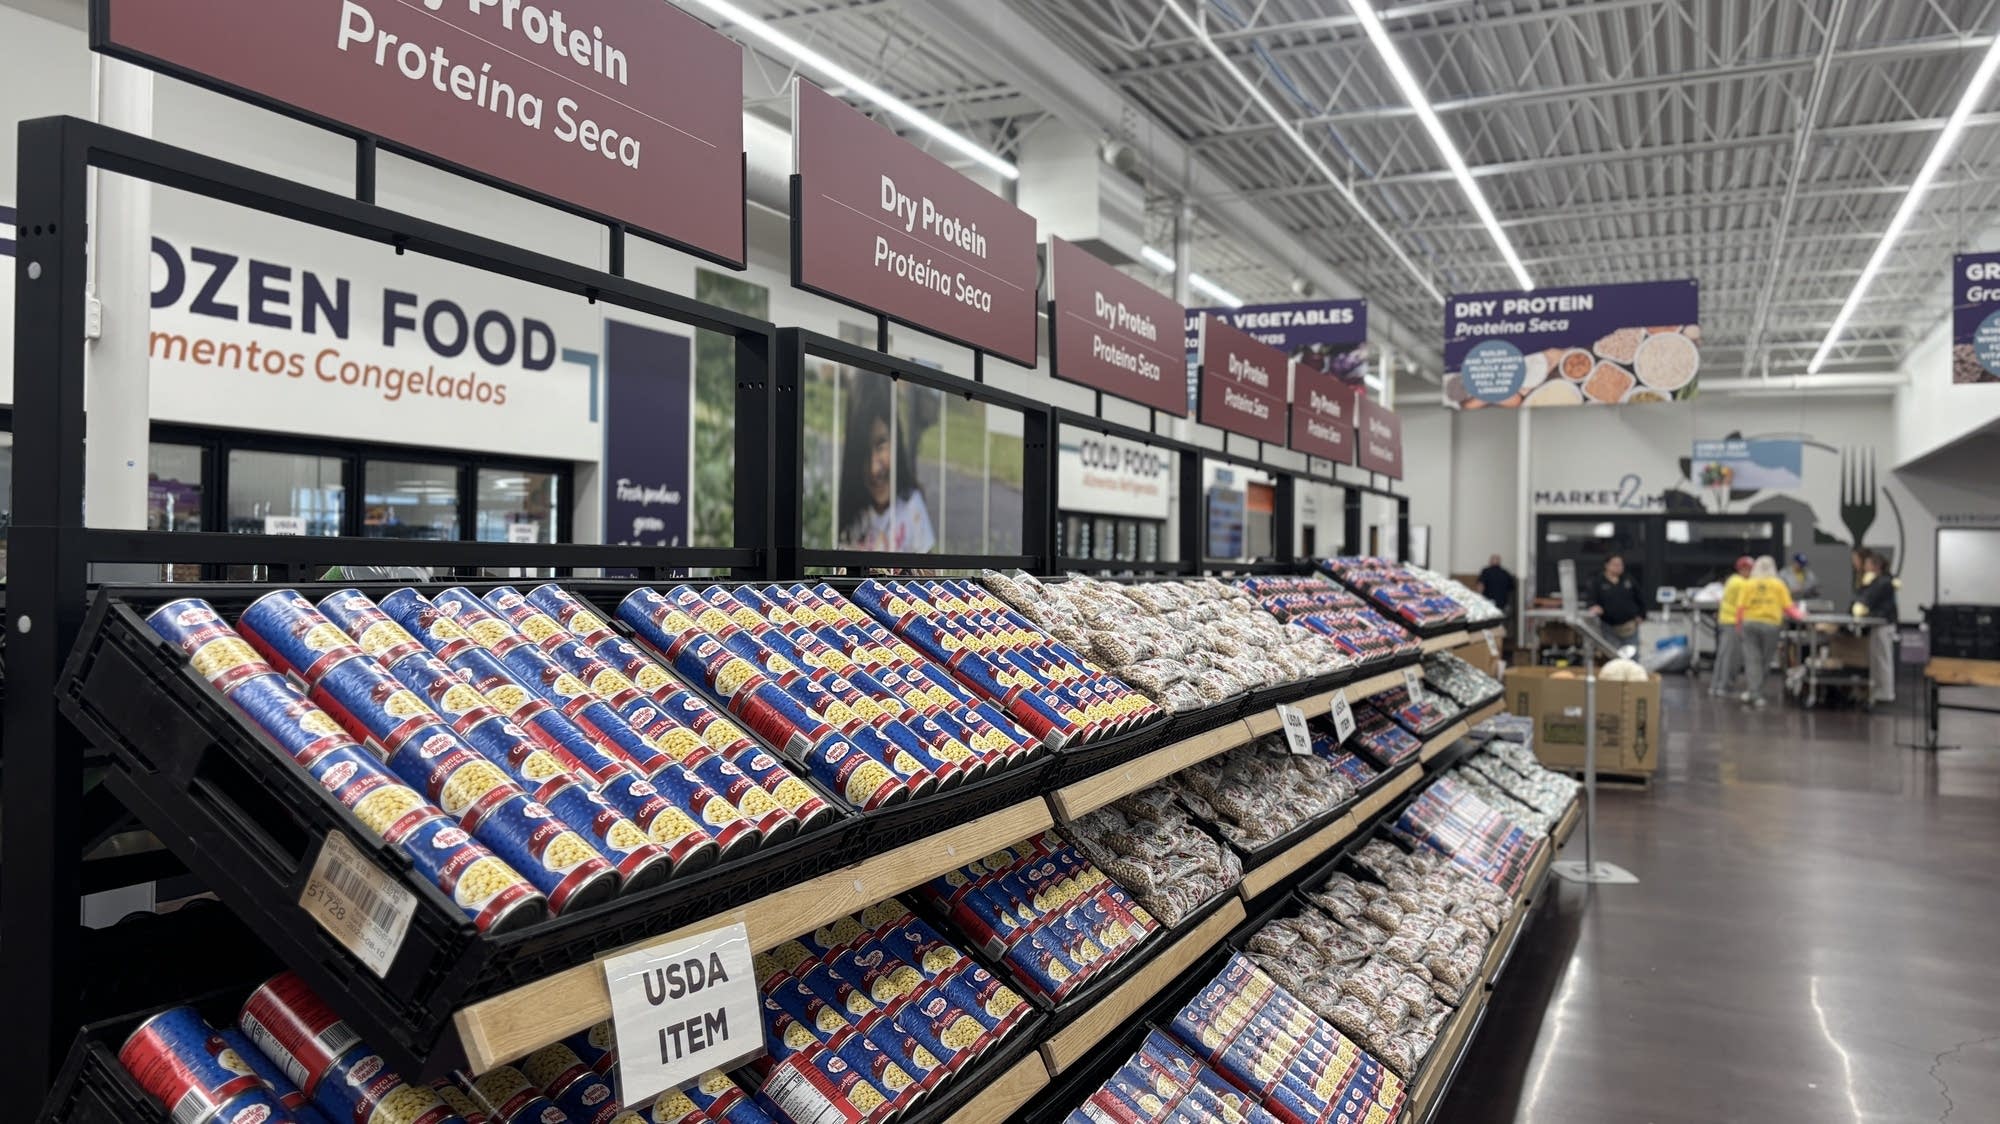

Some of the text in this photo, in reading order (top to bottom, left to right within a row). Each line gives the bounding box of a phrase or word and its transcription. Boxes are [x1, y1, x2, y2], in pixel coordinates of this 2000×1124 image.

[337, 0, 641, 170] Proteína Seca
[881, 174, 987, 259] Dry Protein
[875, 235, 991, 312] Proteína Seca
[383, 288, 557, 372] FOOD
[1095, 290, 1157, 342] Dry Protein
[1233, 307, 1354, 329] VEGETABLES
[1454, 294, 1594, 318] DRY PROTEIN
[1528, 317, 1570, 333] Seca
[315, 348, 507, 405] Congelados
[1138, 352, 1160, 381] Seca
[1229, 352, 1243, 382] Dry
[1243, 358, 1269, 388] Protein
[1081, 440, 1159, 478] COLD FOOD
[307, 884, 346, 921] 51728
[642, 951, 729, 1007] USDA
[658, 1006, 729, 1065] ITEM
